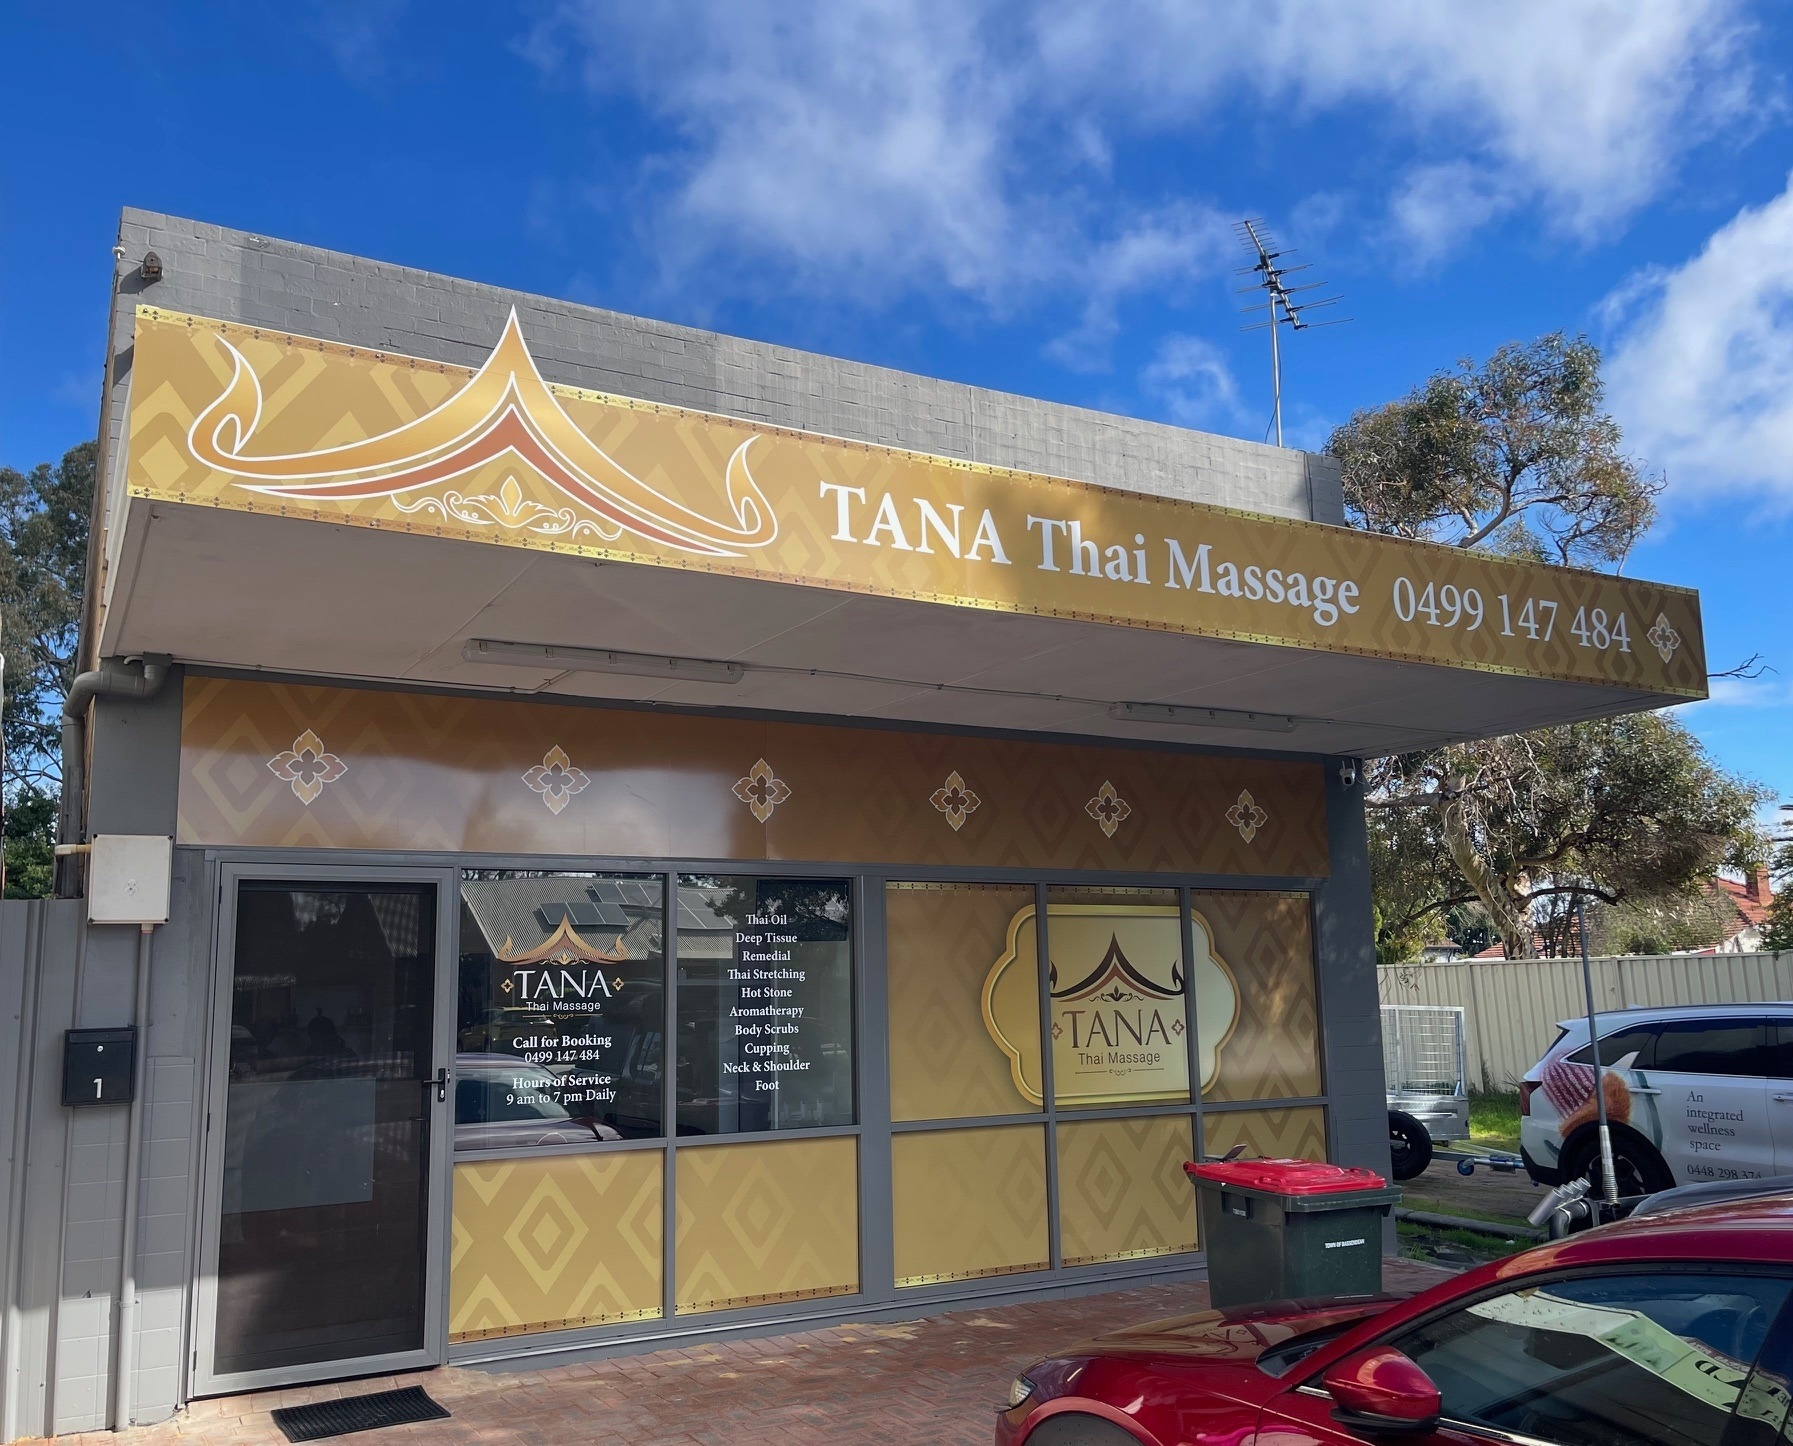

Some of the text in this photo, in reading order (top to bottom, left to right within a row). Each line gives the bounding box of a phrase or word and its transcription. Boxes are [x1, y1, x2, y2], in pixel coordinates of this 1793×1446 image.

[819, 480, 1631, 653] TANA Thai Massage 0499 147 484
[746, 914, 787, 925] Thai Oil
[735, 932, 798, 946] Deep Tissue
[742, 950, 791, 961] Remedial
[727, 969, 806, 982] Thai Stretching
[513, 969, 612, 999] TANA
[741, 986, 793, 998] Hot Stone
[525, 1000, 601, 1012] Thai Massage
[729, 1005, 804, 1018] Aromatherapy
[735, 1023, 799, 1037] Body Scrubs
[1062, 1008, 1172, 1048] TANA
[512, 1033, 612, 1049] Call for Booking
[524, 1049, 600, 1063] 0499 147 484
[744, 1042, 790, 1056] Cupping
[1078, 1052, 1161, 1065] Thai Massage
[722, 1060, 810, 1073] Neck & Shoulder
[93, 1078, 103, 1099] 1
[512, 1073, 612, 1090] Hours of Service
[755, 1079, 780, 1091] Foot
[506, 1088, 617, 1106] 9 am to 7 pm Daily
[1686, 1090, 1704, 1103] An
[1686, 1106, 1744, 1123] integrated
[1688, 1122, 1736, 1137] wellness
[1689, 1140, 1722, 1153] space
[1687, 1164, 1714, 1177] 0448
[1717, 1167, 1739, 1180] 298
